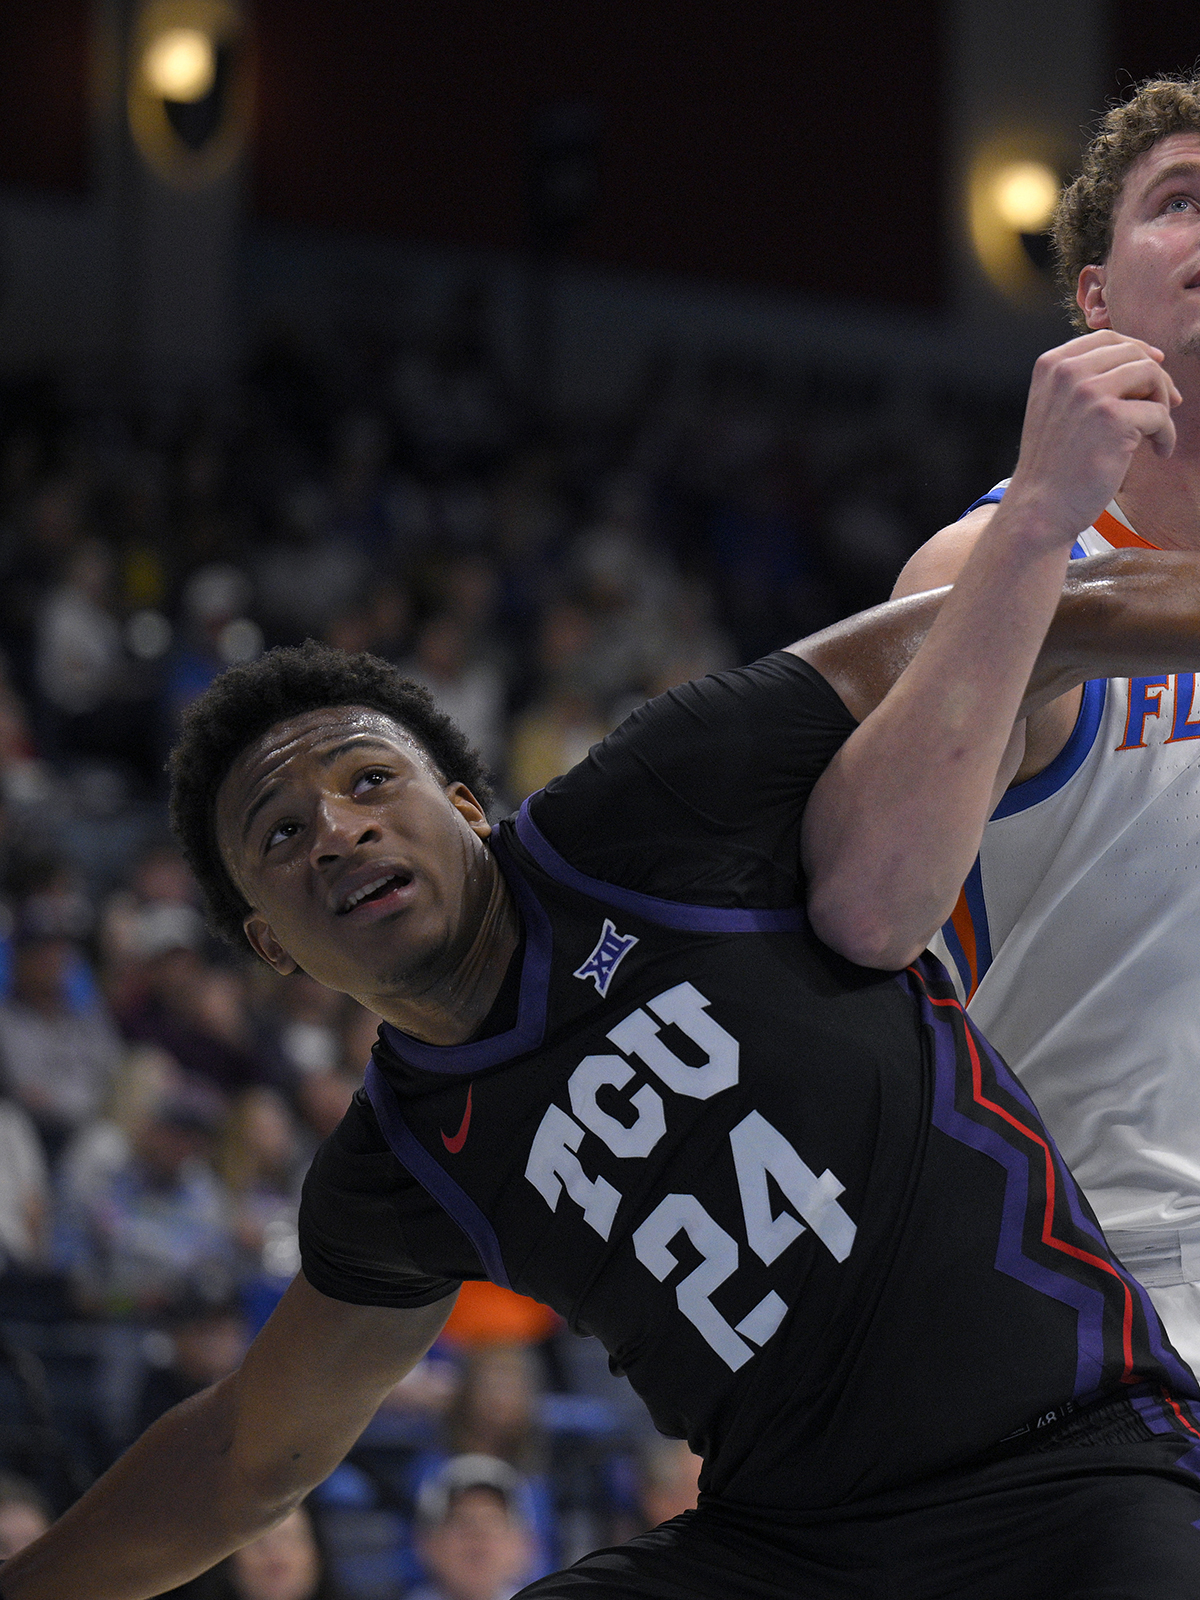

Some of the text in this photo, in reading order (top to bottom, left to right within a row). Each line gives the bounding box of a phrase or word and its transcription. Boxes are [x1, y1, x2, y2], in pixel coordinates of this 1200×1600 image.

[575, 920, 637, 995] XII
[524, 981, 740, 1243] TCU
[632, 1109, 858, 1374] 24
